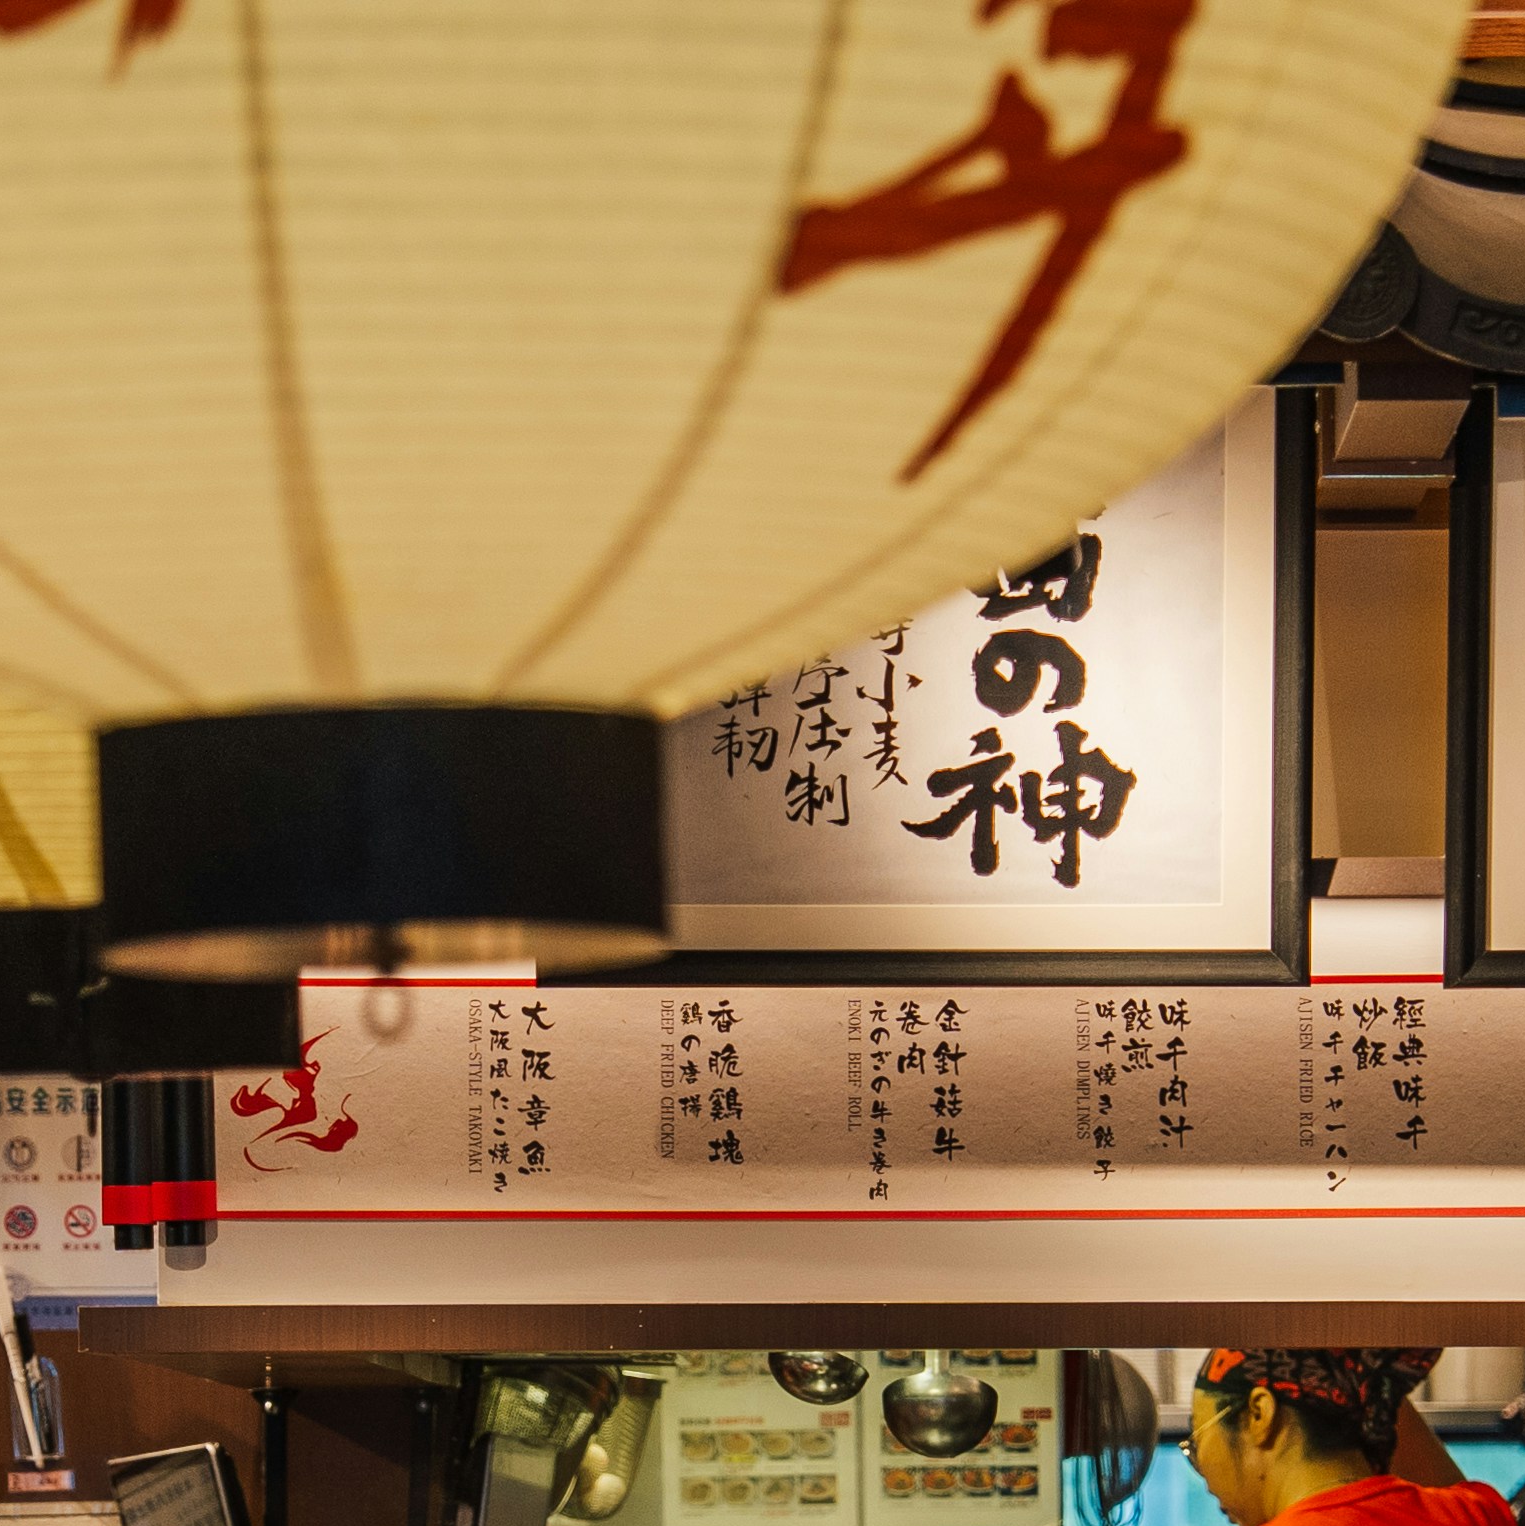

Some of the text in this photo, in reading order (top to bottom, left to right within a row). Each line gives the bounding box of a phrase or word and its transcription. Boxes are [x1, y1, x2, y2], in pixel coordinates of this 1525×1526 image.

[468, 999, 483, 1174] OSAKA-STYLE TAKOYAKI
[517, 1000, 555, 1176] 大阪章魚
[661, 999, 675, 1159] DEEP FRIED CHICKEN
[847, 1000, 862, 1132] ENOKI BEEF ROLL
[929, 999, 970, 1161] 金針菇牛
[1075, 999, 1091, 1140] AJISEN DUMPLINGS
[1155, 998, 1194, 1149] 味千肉汁
[1299, 998, 1314, 1147] AJISEN FRIED RICE
[1352, 998, 1388, 1070] 炒飯
[1392, 996, 1428, 1150] 經典味千
